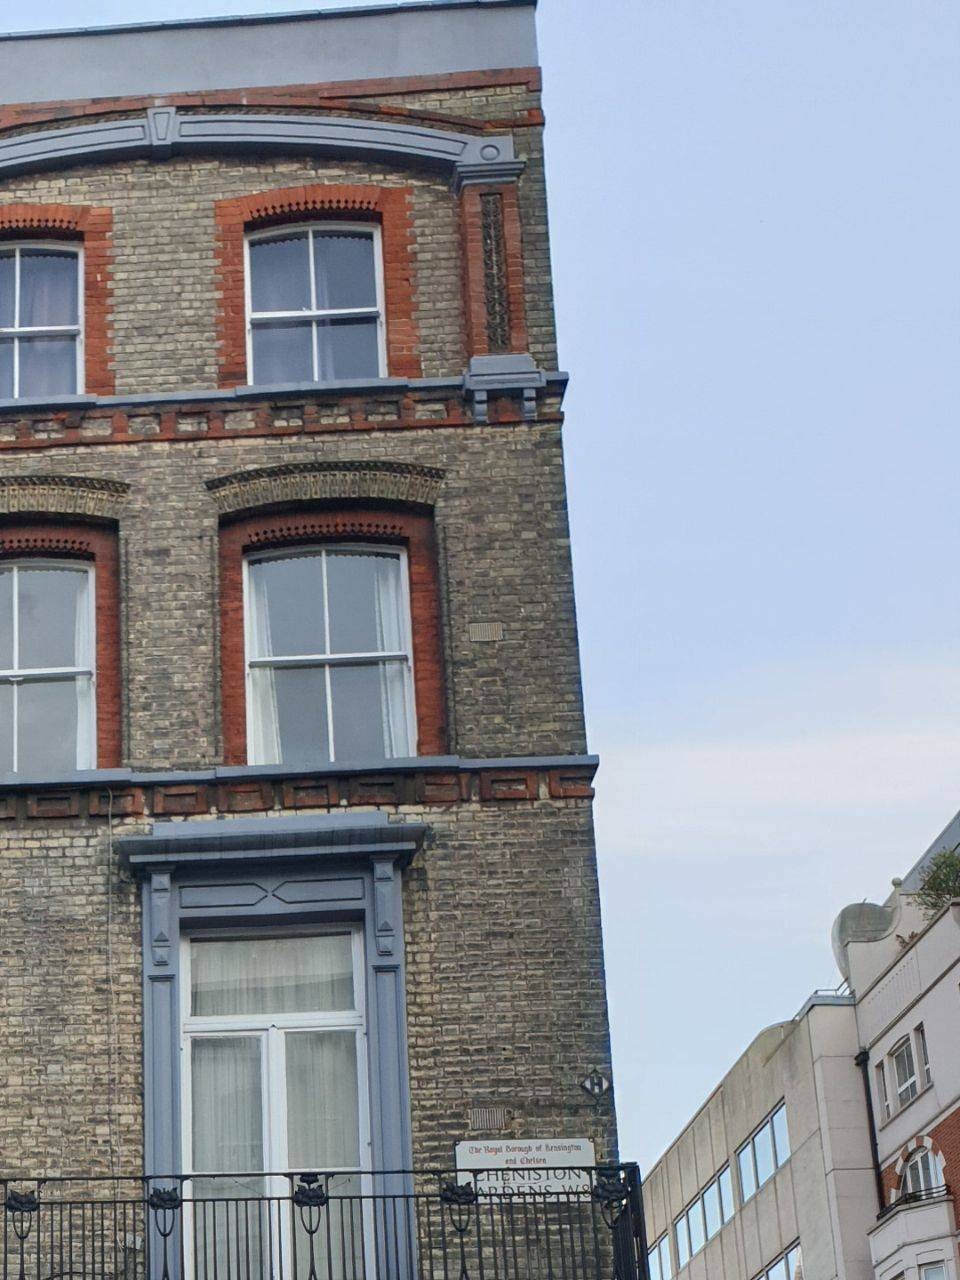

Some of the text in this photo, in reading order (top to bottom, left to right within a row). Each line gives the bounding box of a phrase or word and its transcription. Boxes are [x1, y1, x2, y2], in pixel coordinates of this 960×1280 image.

[469, 1145, 481, 1154] The
[483, 1144, 503, 1156] Royal
[506, 1144, 532, 1154] Borough
[545, 1143, 581, 1153] Kensington
[505, 1156, 546, 1164] and Chelsea
